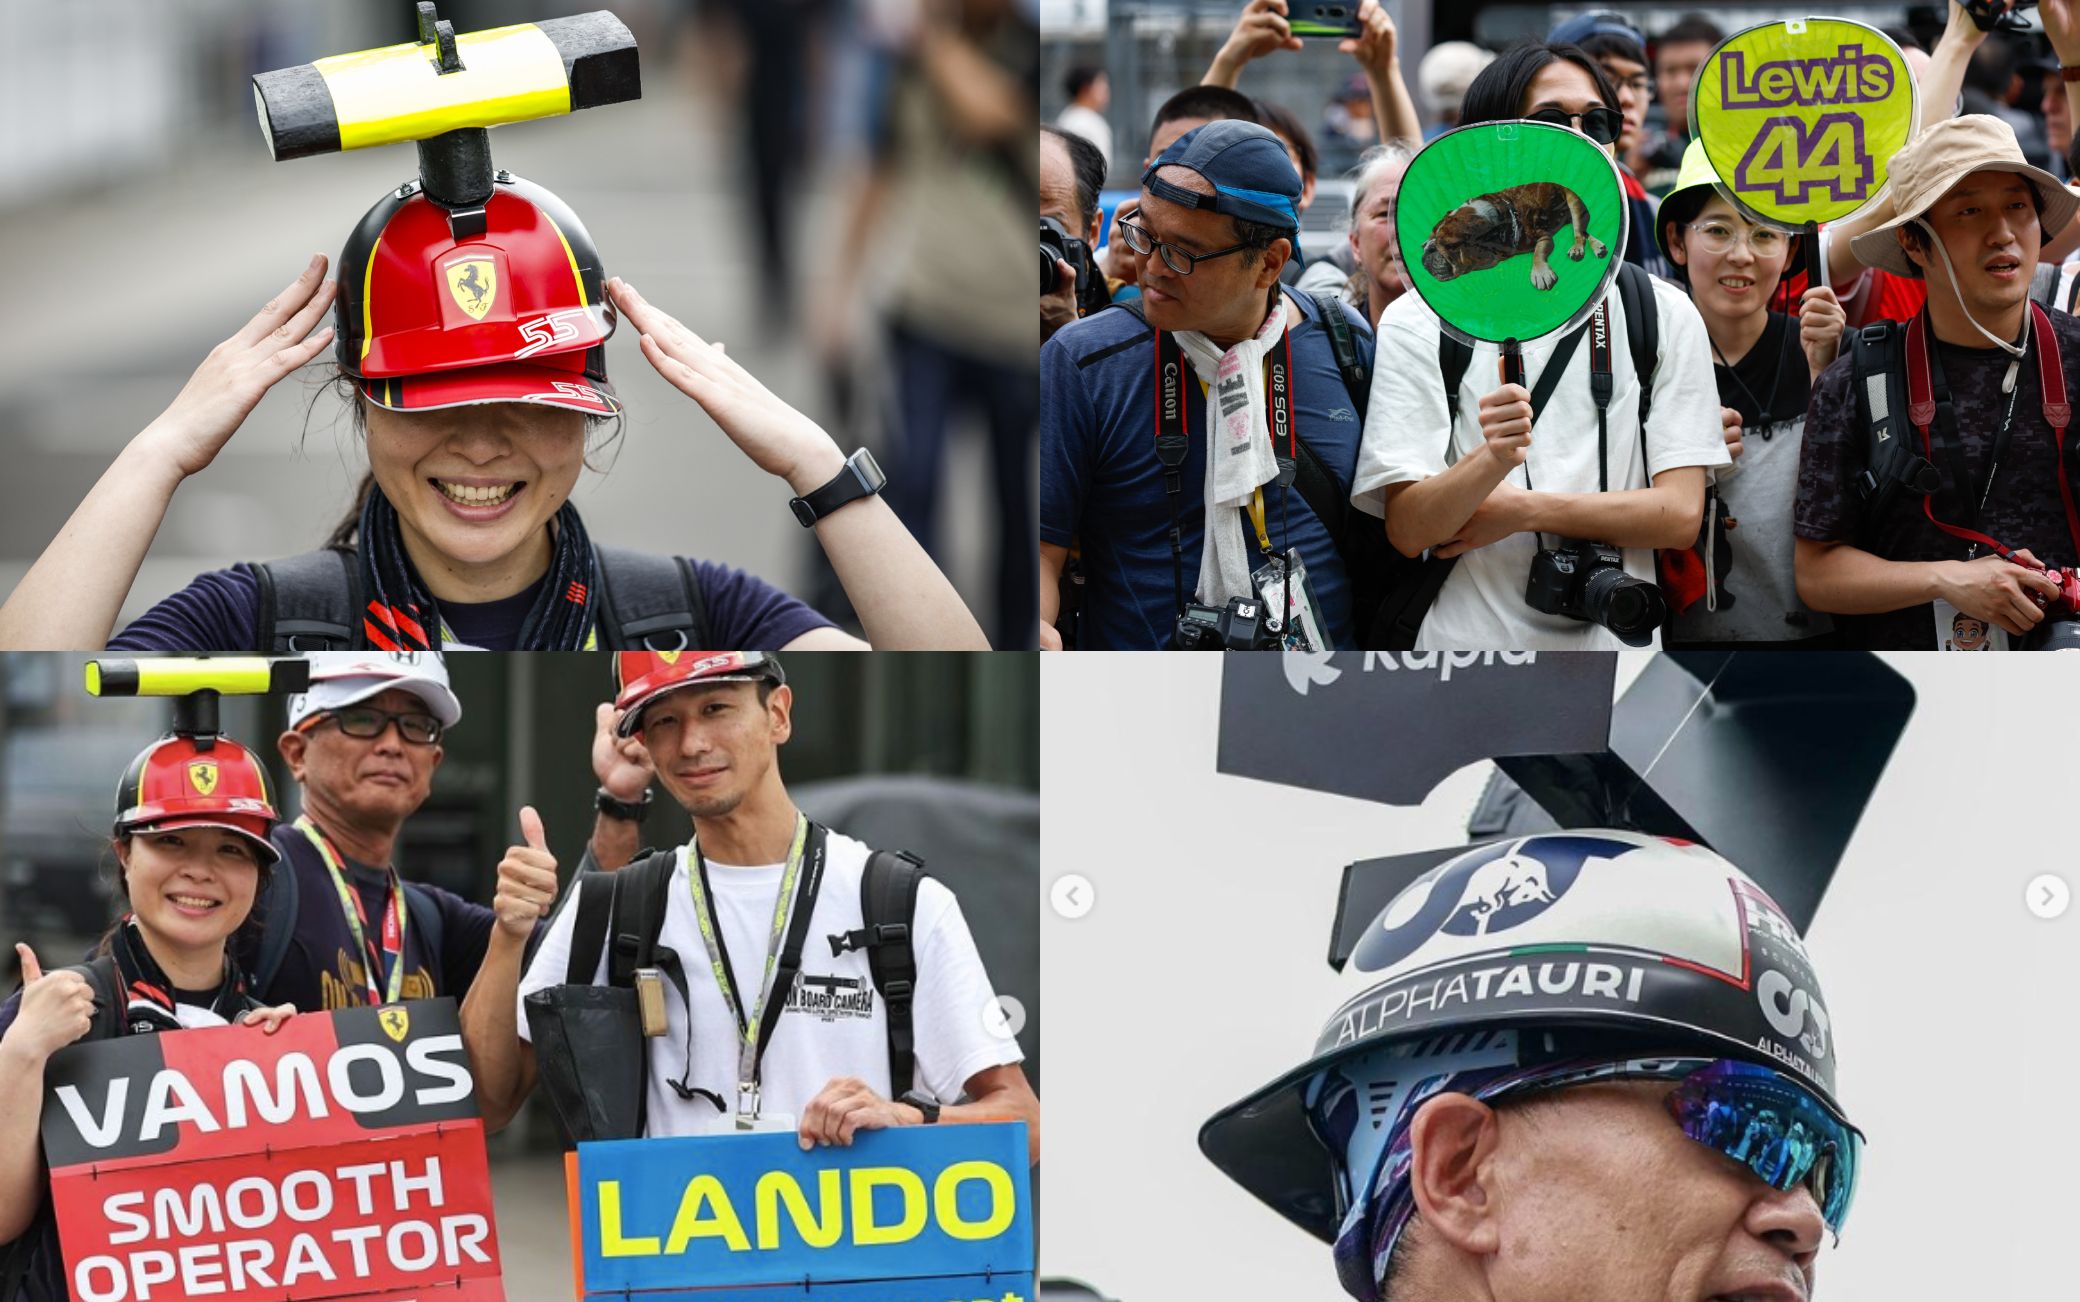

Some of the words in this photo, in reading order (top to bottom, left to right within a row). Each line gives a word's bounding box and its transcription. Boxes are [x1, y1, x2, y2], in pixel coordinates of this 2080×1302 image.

[1720, 44, 1894, 110] Lewis
[1735, 112, 1874, 205] 44
[515, 308, 582, 359] 55
[550, 381, 605, 404] 55
[1164, 362, 1178, 421] Canon
[1273, 363, 1285, 393] 80D
[1274, 396, 1287, 437] EOS
[800, 988, 832, 1009] BOARD
[834, 988, 874, 1012] CAMERA
[1335, 962, 1645, 1048] ALPHATAURI
[54, 1033, 474, 1149] VAMOS
[102, 1155, 444, 1245] SMOOTH
[598, 1161, 1016, 1257] LANDO
[74, 1213, 492, 1302] OPERATOR
